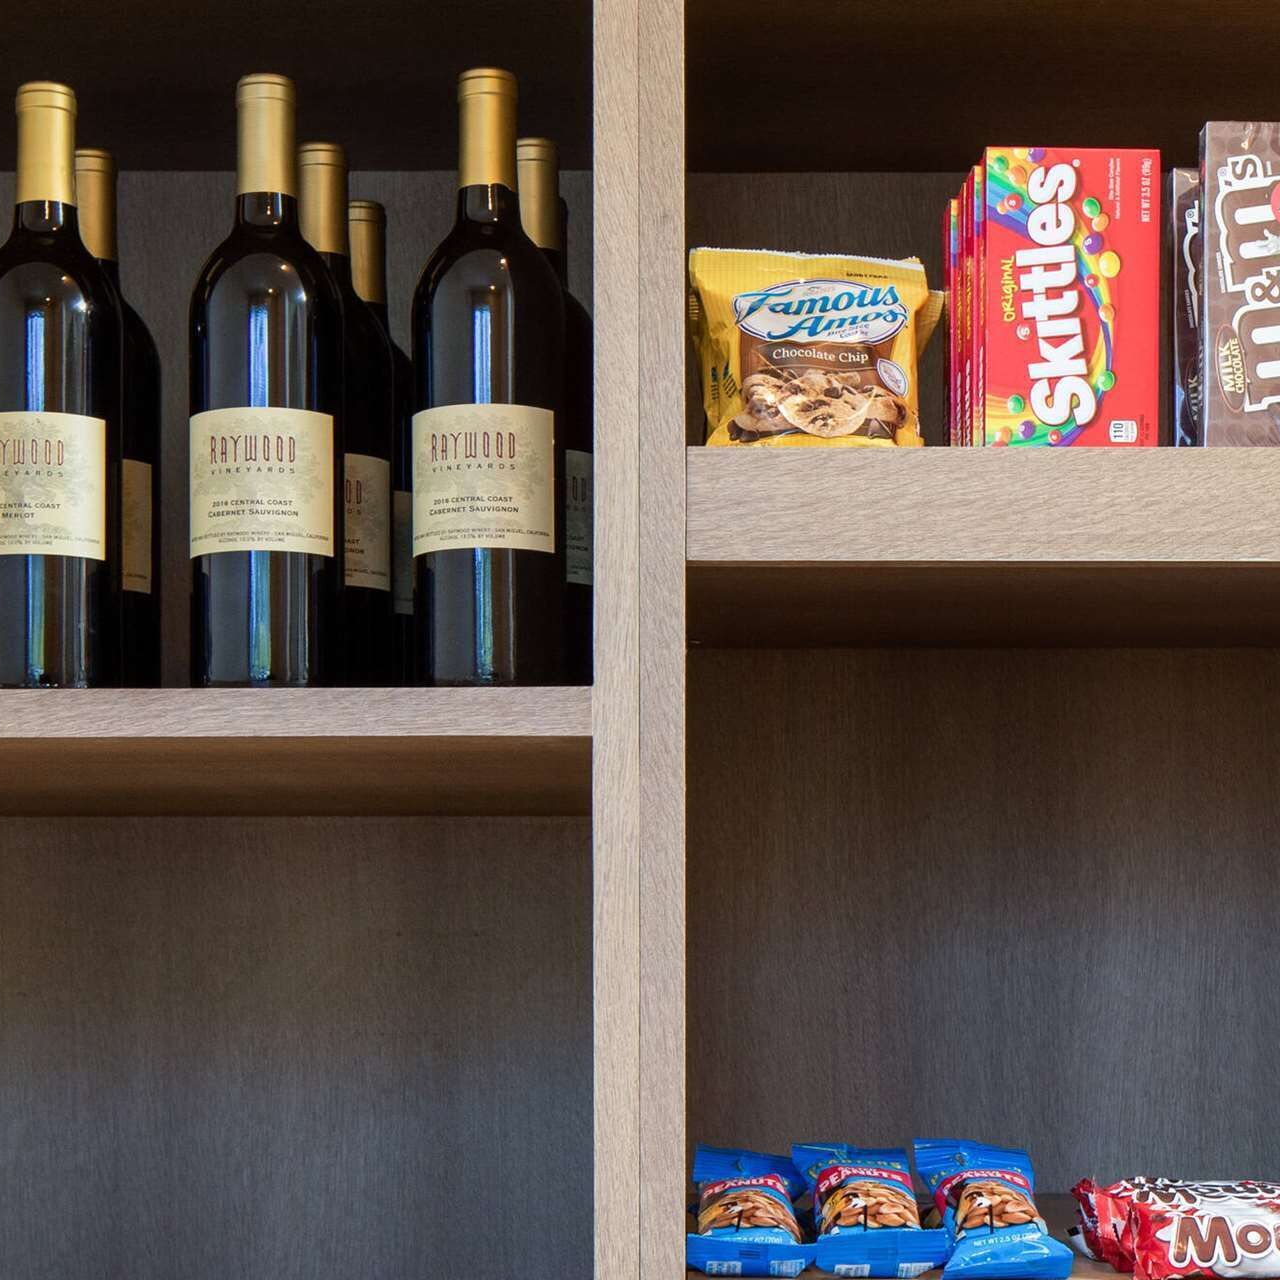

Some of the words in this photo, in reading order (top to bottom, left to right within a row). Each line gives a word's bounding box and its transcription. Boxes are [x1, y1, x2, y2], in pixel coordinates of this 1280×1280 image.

[734, 284, 901, 325] Famous
[1015, 162, 1097, 426] Skittles
[767, 310, 909, 340] Amos
[773, 348, 835, 363] Chocolate
[838, 352, 869, 365] Chip
[1217, 342, 1234, 392] MILK
[1229, 337, 1245, 393] CHOCOLATE
[1113, 423, 1124, 440] 110
[210, 435, 296, 465] RAYWOOD
[431, 432, 516, 462] RAYWOOD
[211, 466, 295, 475] VINEYARDS
[432, 463, 516, 473] VINEYARDS
[0, 502, 32, 510] CENTRAL
[230, 499, 265, 507] CENTRAL
[267, 499, 293, 507] COAST
[451, 496, 486, 504] CENTRAL
[819, 1167, 904, 1193] PEANUTS
